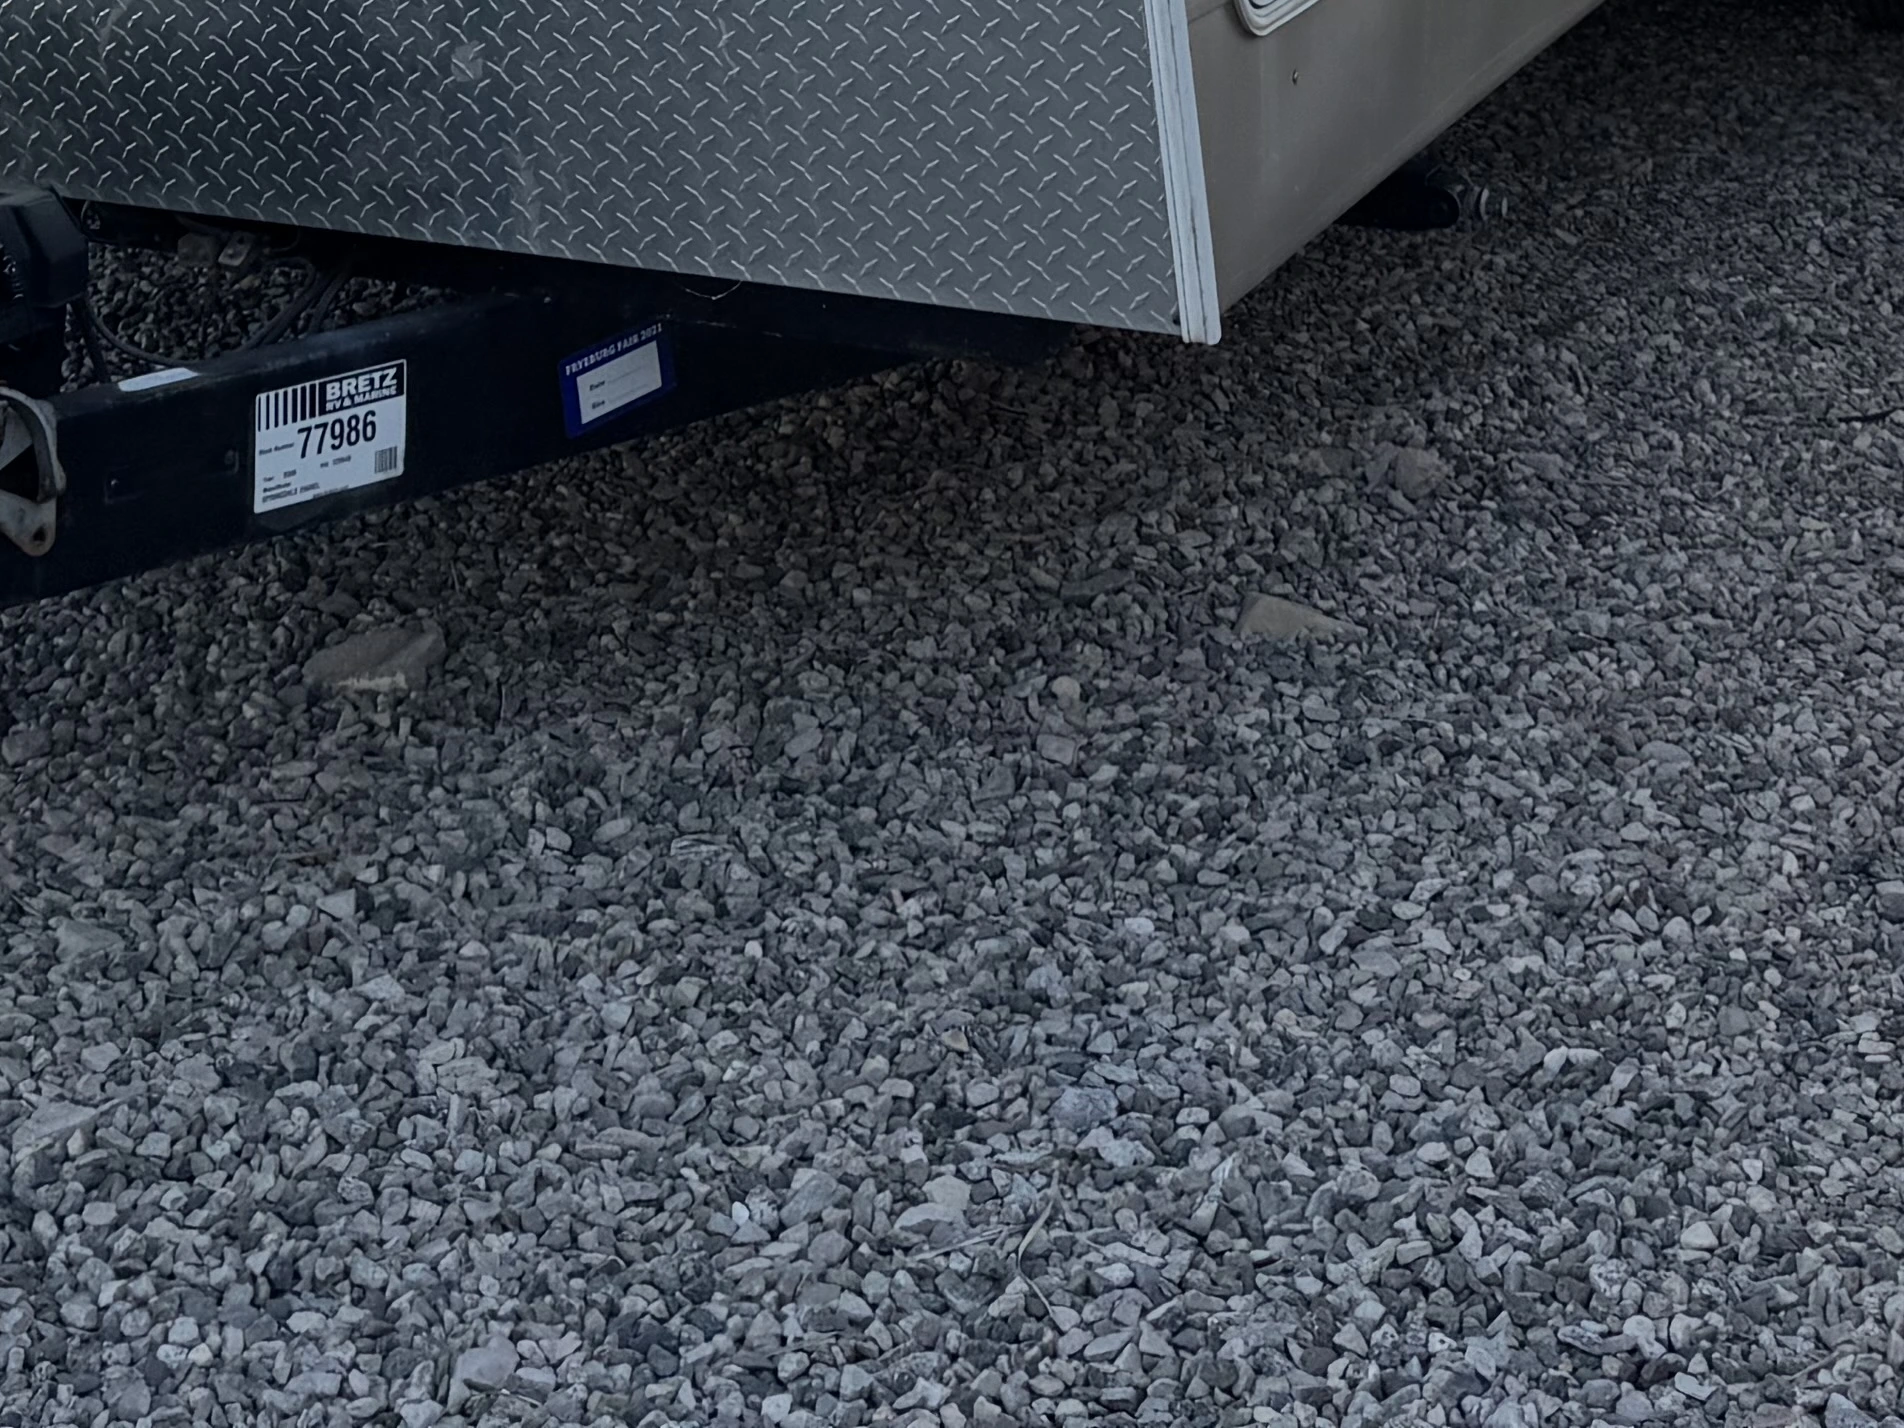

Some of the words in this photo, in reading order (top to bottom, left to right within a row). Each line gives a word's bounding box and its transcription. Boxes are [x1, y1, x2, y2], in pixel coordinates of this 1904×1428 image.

[617, 333, 639, 351] FAIR
[325, 367, 398, 401] BRETZ
[325, 399, 341, 413] RV
[353, 385, 398, 405] MARINE
[297, 409, 376, 459] 77986
